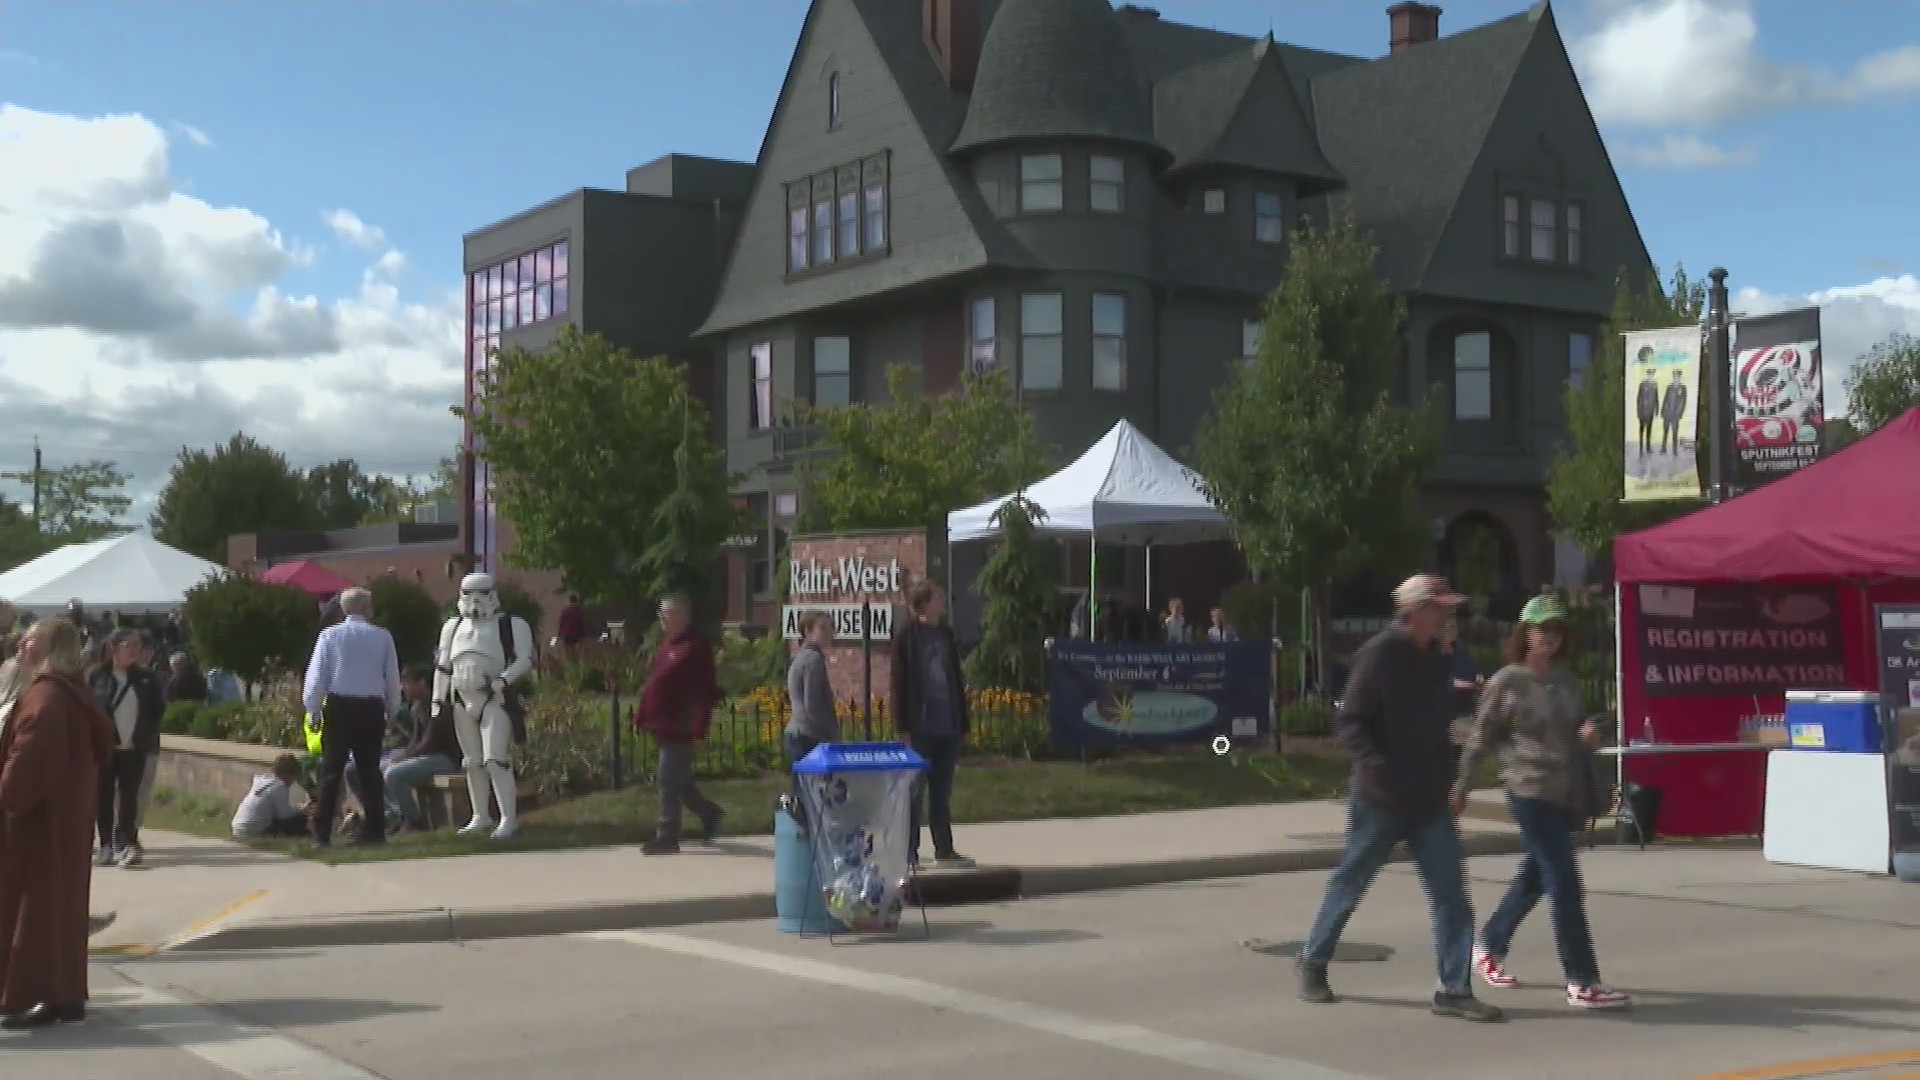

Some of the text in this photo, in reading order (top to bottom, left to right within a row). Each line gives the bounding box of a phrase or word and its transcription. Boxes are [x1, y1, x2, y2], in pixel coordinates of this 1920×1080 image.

[1741, 445, 1819, 460] SPUTNIKFEST
[790, 556, 900, 593] Rahr-West
[826, 609, 887, 634] USEM
[1647, 628, 1827, 648] REGISTRATION
[1095, 665, 1158, 681] September
[1645, 664, 1845, 684] & INFORMATION
